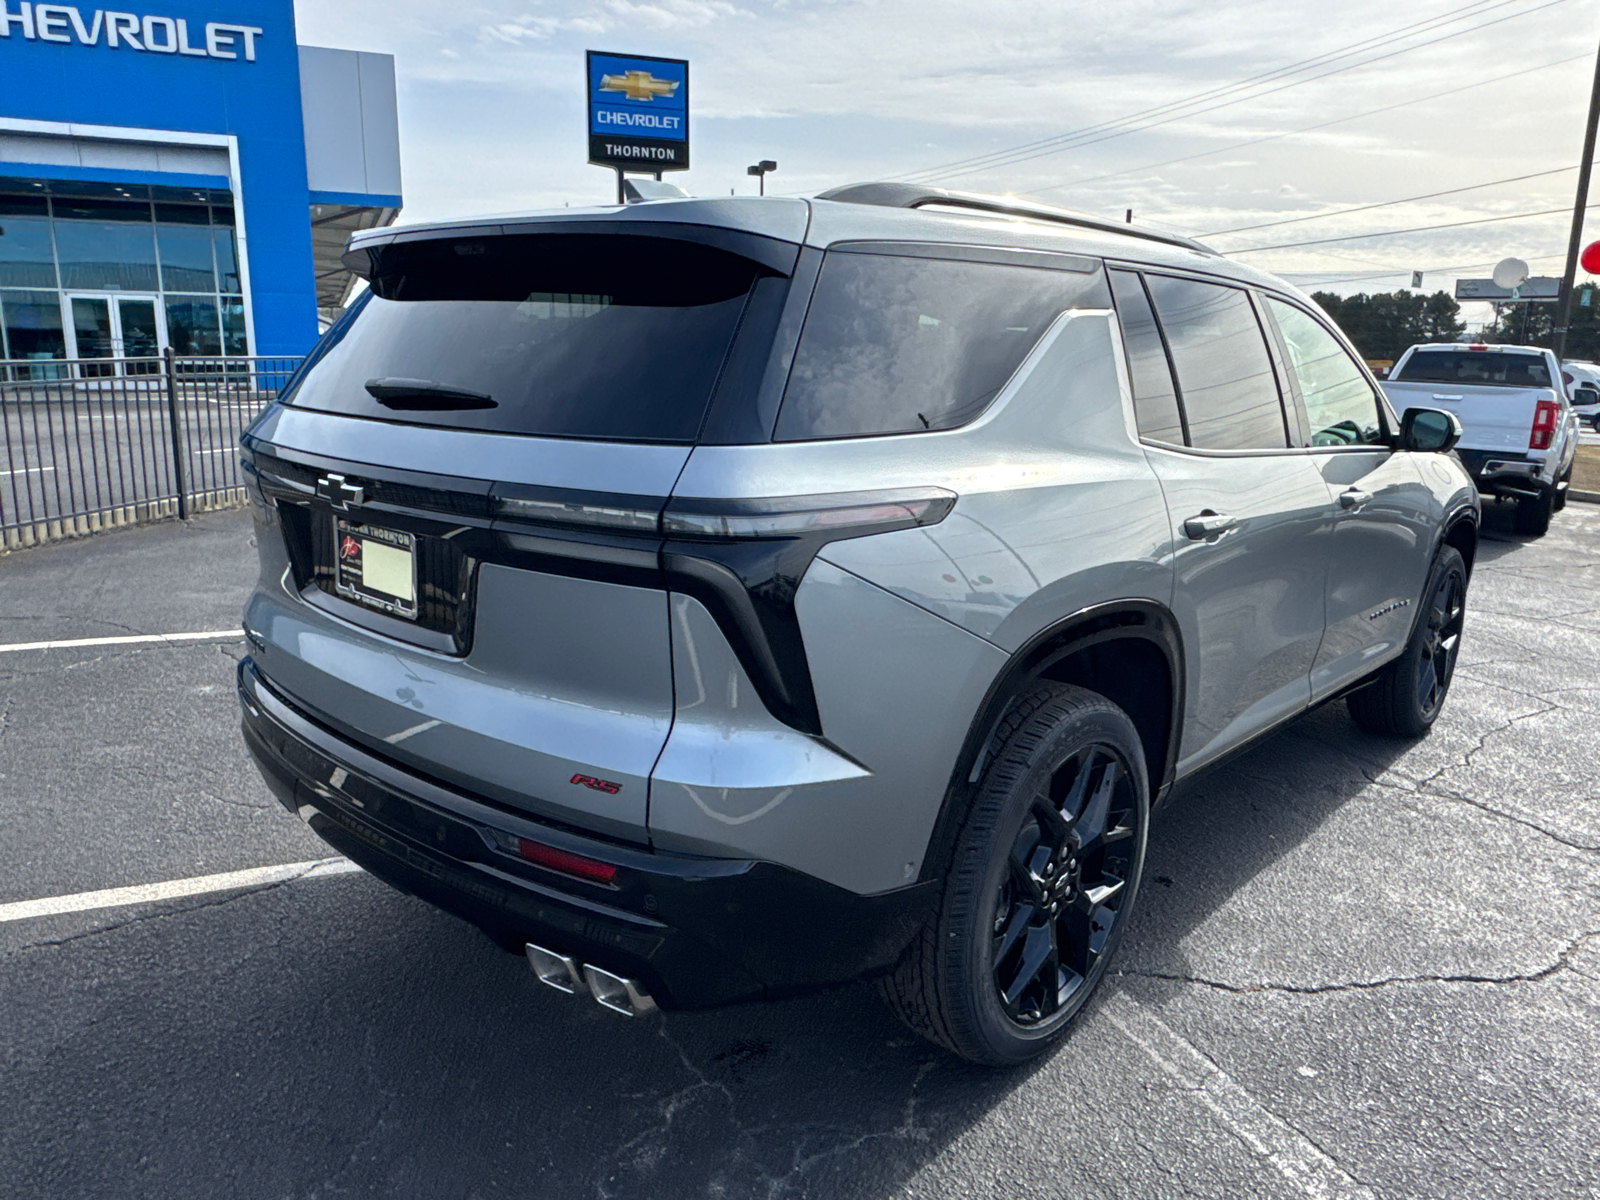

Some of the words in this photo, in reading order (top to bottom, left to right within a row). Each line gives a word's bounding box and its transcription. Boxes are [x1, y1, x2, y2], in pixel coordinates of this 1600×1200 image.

[597, 110, 680, 129] CHEVROLET
[605, 144, 675, 160] THORNTON
[569, 773, 623, 794] RS
